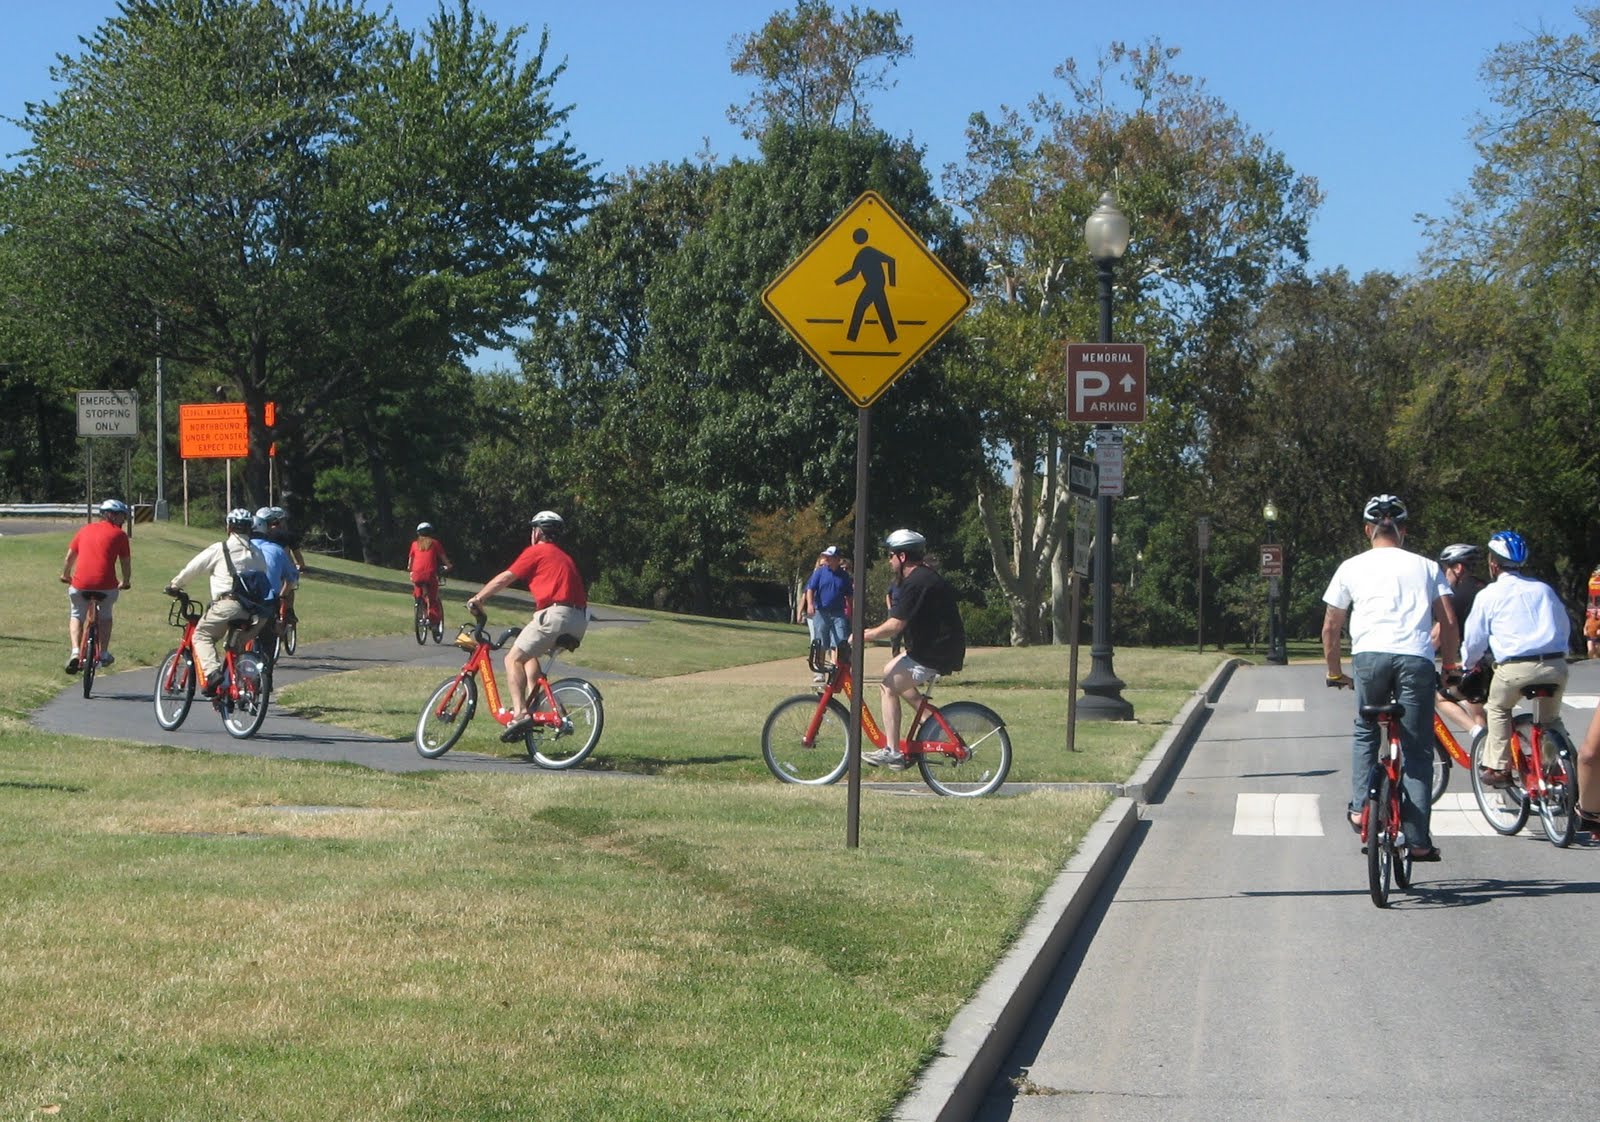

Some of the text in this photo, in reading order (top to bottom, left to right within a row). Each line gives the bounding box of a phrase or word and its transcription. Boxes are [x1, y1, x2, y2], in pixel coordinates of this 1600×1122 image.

[1082, 353, 1132, 363] MEMORIAL
[80, 396, 135, 406] EMERGENCY
[85, 409, 131, 418] STOPPING
[95, 422, 120, 431] ONLY
[190, 423, 240, 431] NORTHBOUND
[185, 433, 248, 442] UNDER CONSTRU
[229, 443, 247, 451] DELA
[1435, 724, 1460, 759] bikeshare
